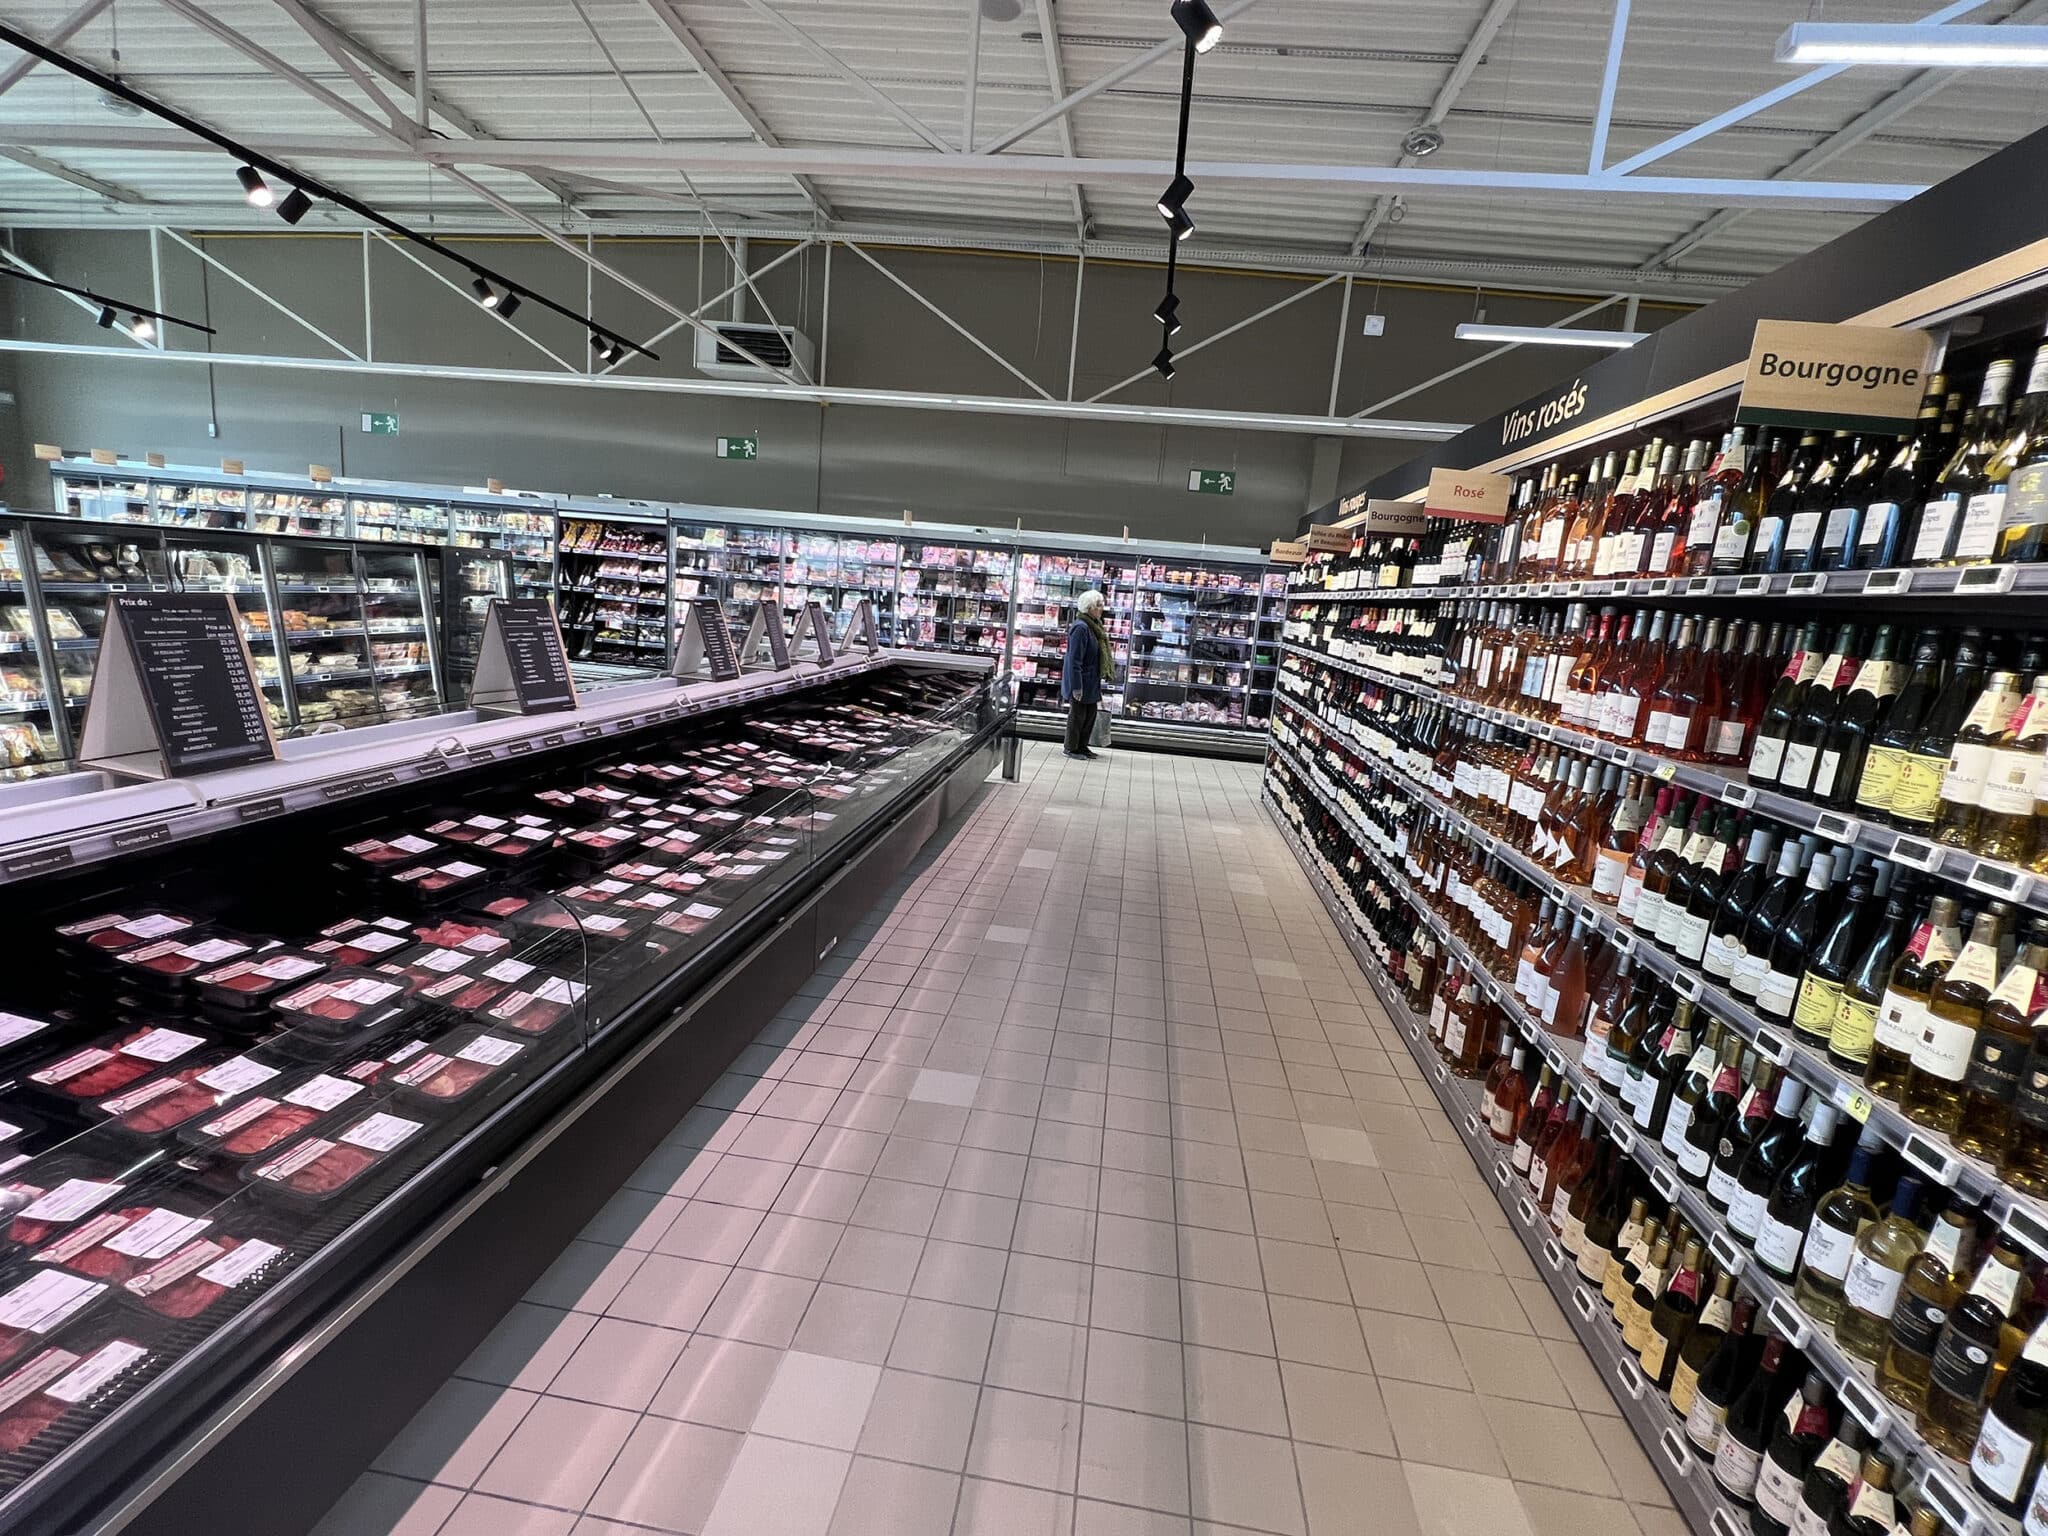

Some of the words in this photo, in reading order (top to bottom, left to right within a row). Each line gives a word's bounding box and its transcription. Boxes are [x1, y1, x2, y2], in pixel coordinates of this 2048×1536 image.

[1758, 352, 1919, 389] Bourgogne
[1501, 408, 1535, 446] Vins
[1536, 378, 1589, 431] rosés
[1453, 484, 1485, 499] Rosé
[1371, 510, 1425, 525] Bourgogne
[119, 598, 136, 607] Prix
[137, 598, 148, 607] de
[1855, 1096, 1864, 1110] 6
